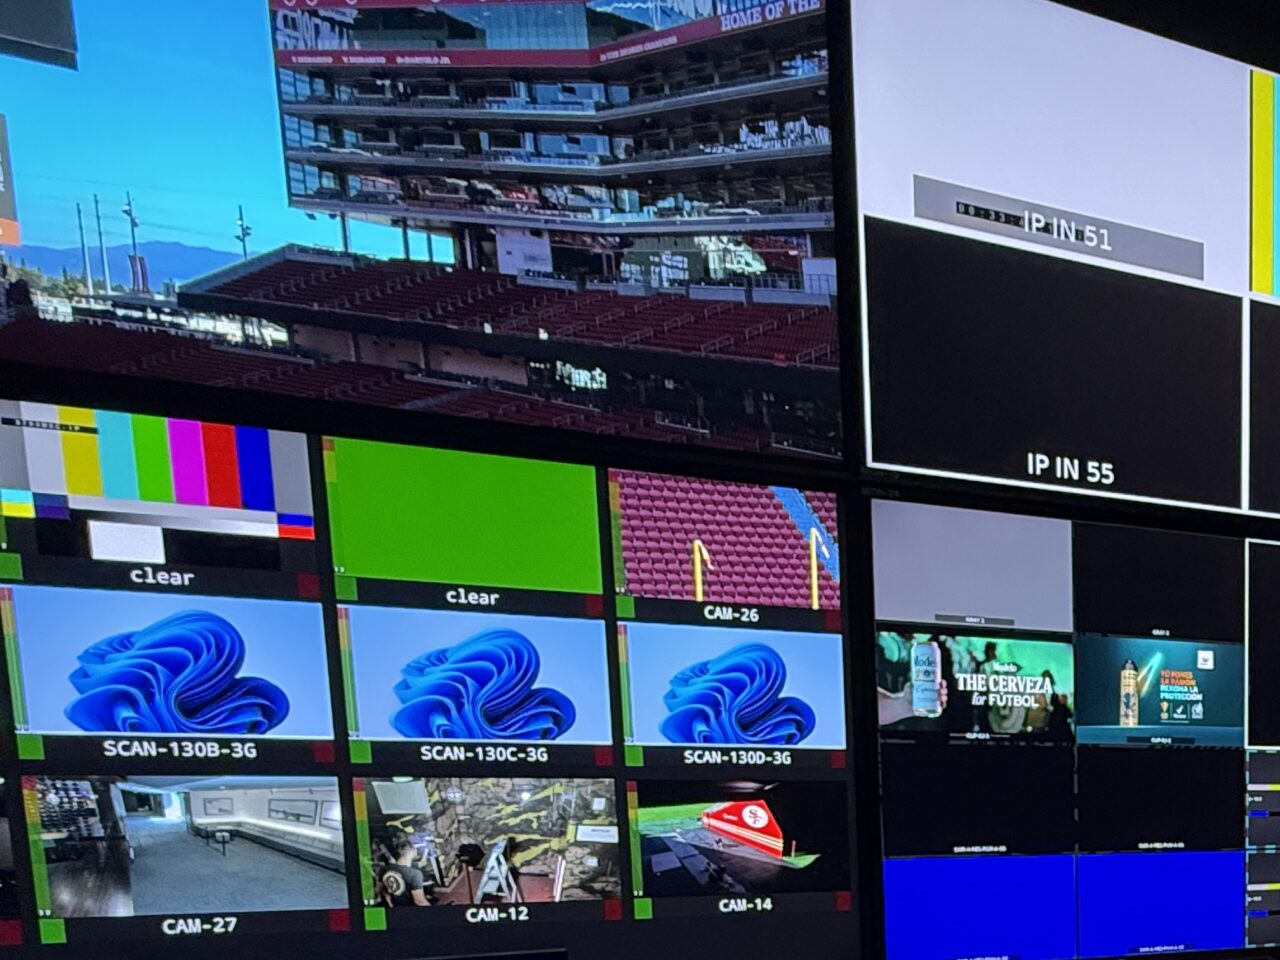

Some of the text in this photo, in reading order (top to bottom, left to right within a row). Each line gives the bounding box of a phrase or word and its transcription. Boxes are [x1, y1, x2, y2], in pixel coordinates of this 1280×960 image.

[721, 0, 820, 31] HOME OF THE
[1024, 210, 1112, 250] IP IN 51
[1027, 452, 1115, 484] IP IN 55
[130, 567, 195, 586] clear
[445, 587, 500, 607] clear
[704, 605, 760, 623] CAM-26
[956, 674, 987, 692] THE
[988, 675, 1053, 694] CERVEZA
[971, 692, 986, 706] for
[103, 740, 258, 759] SCAN-130B-3G
[420, 745, 549, 763] SCAN-130C-3G
[683, 749, 792, 766] SCAN-130D-3G
[466, 906, 530, 923] CAM-12
[718, 898, 773, 913] CAM-14
[162, 917, 238, 935] CAM-27
